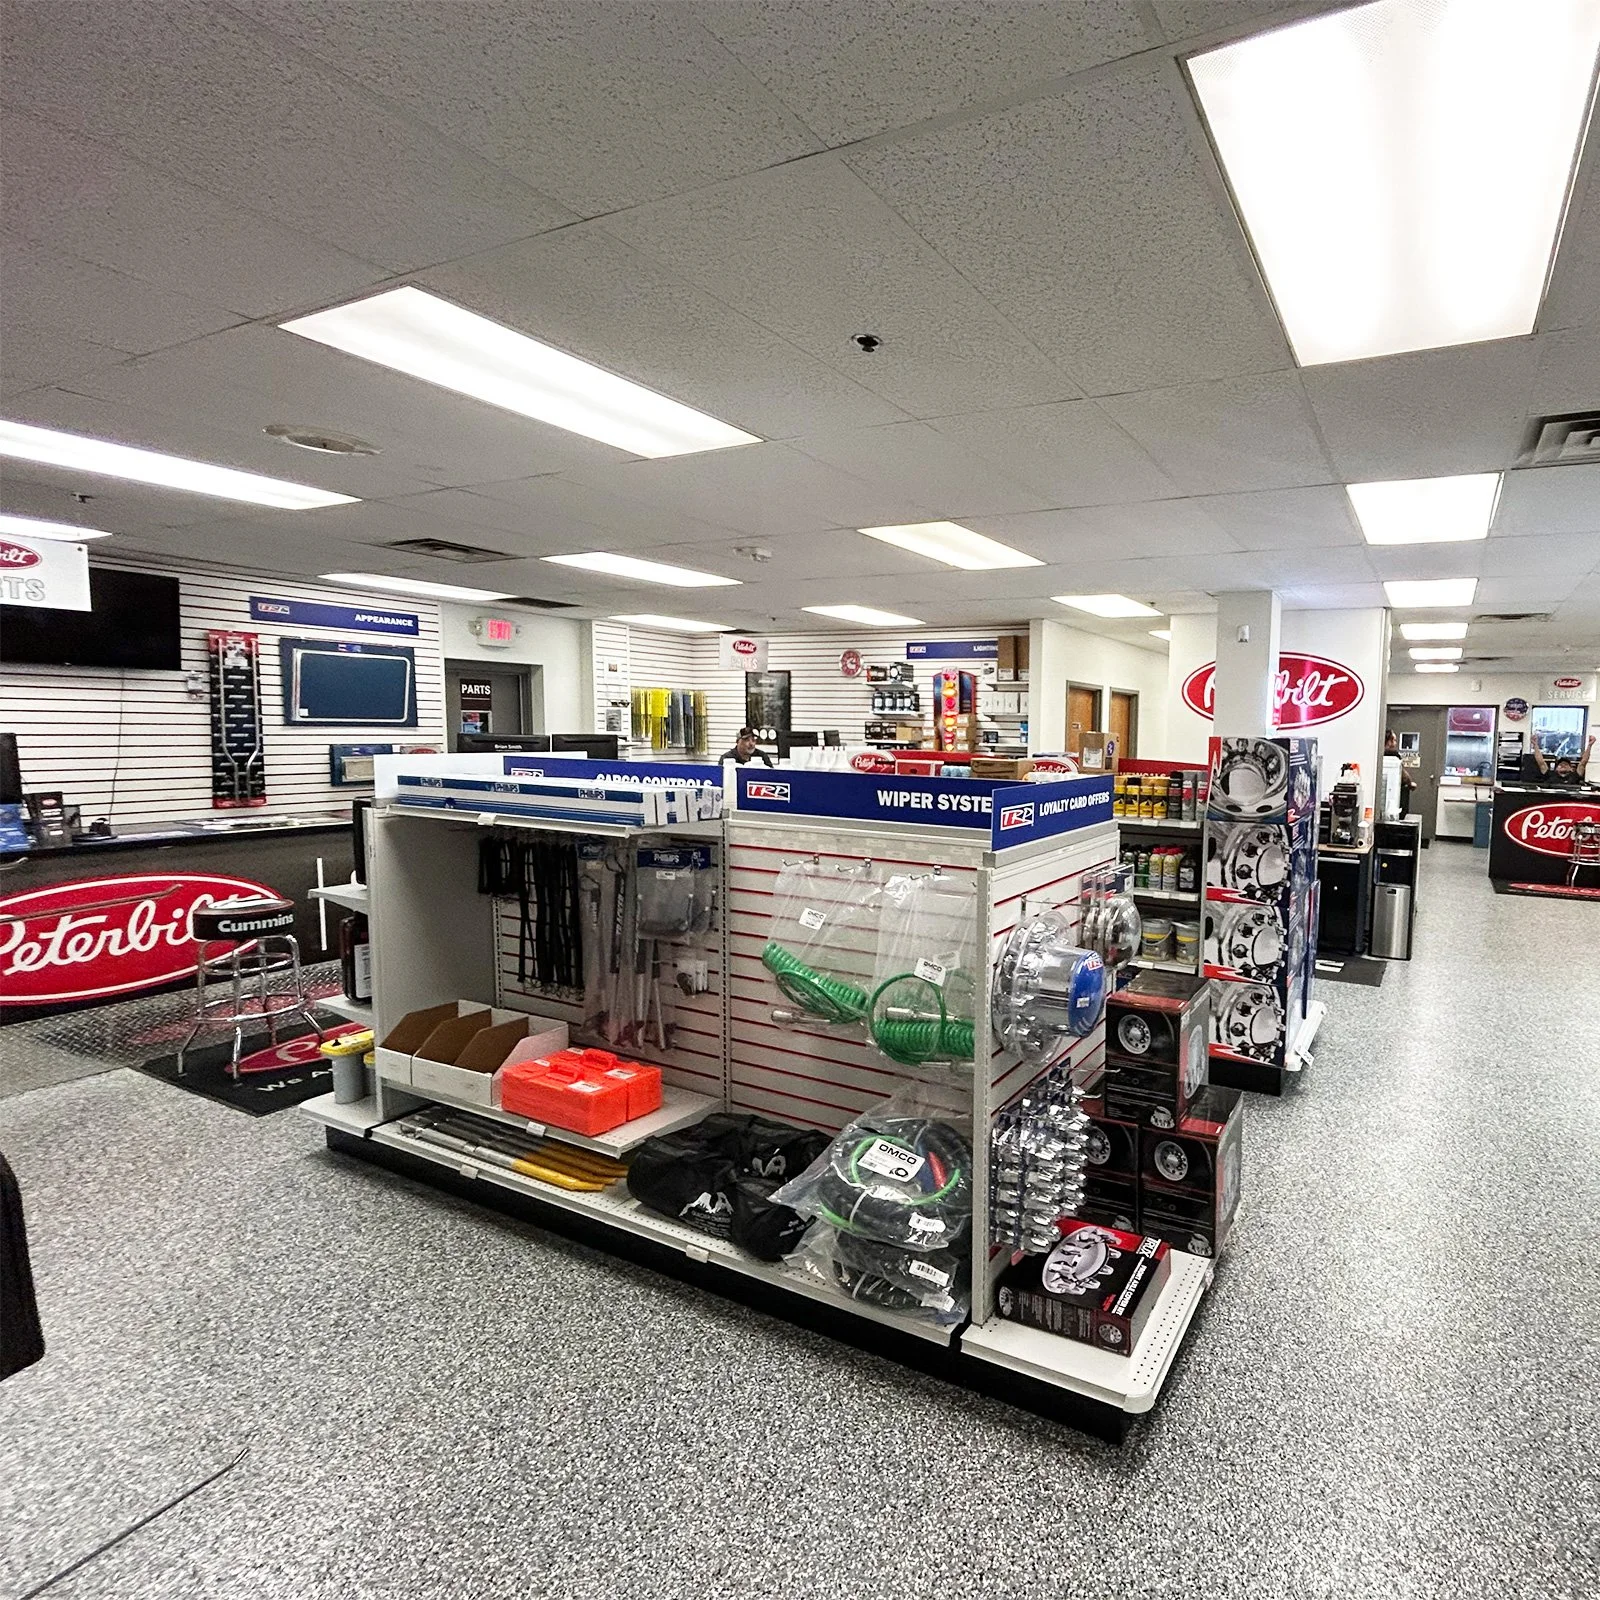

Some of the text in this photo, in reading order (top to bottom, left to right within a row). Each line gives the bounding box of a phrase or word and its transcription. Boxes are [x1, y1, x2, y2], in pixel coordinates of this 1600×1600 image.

[355, 614, 414, 627] APPEARANCE
[461, 684, 491, 695] PARTS
[1547, 690, 1587, 700] SERVICE
[747, 782, 790, 800] TRP
[876, 789, 992, 814] WIPER SYSTE
[1039, 791, 1110, 817] LOYALTY CARD OFFERS
[1002, 805, 1034, 828] TRP
[217, 913, 294, 933] Cummins
[0, 894, 262, 976] eterbil
[878, 1143, 918, 1166] OMCO
[1139, 1236, 1159, 1258] TRUX
